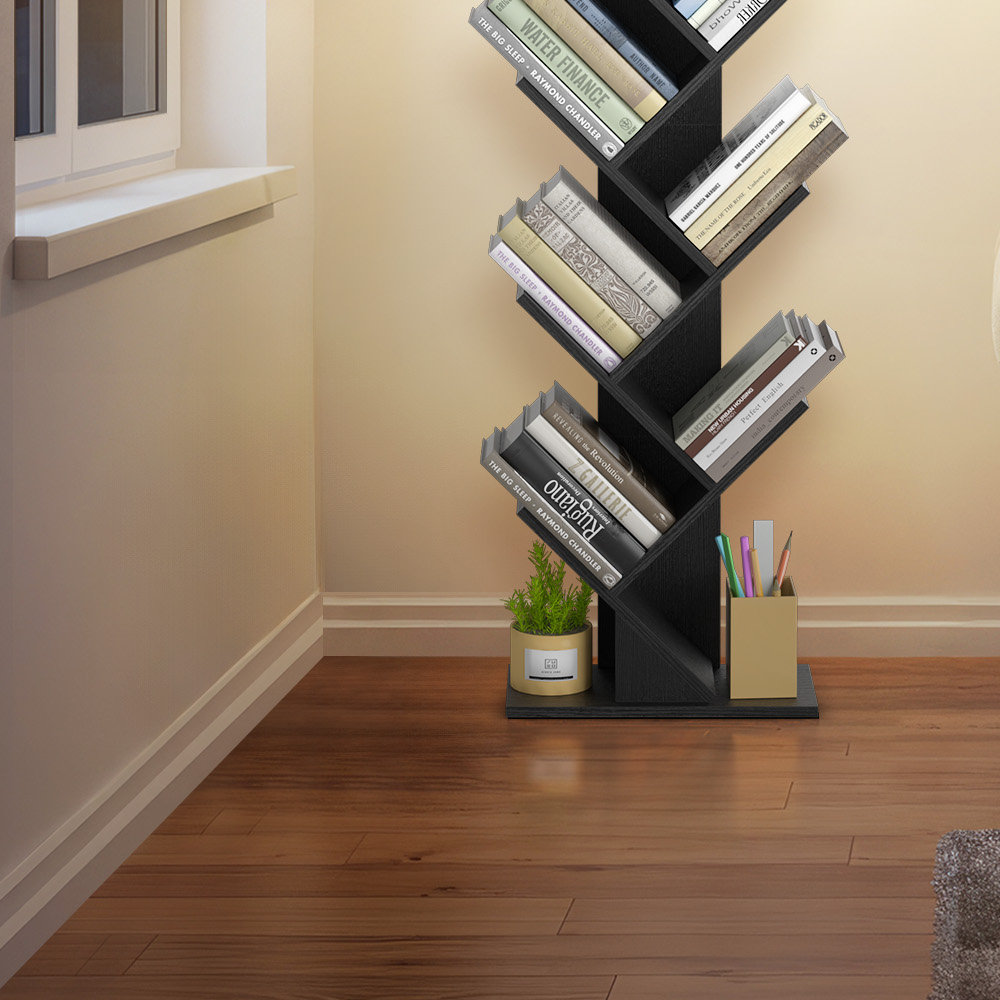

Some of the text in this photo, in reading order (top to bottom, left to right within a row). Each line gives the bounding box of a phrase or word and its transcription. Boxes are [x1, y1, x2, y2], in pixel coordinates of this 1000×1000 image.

[575, 0, 589, 13] END
[476, 17, 493, 33] THE
[490, 31, 506, 46] BIG
[504, 44, 526, 65] SLEEP
[529, 69, 568, 106] RAYMOND
[563, 103, 603, 141] CHANDLER
[518, 19, 563, 62] WATER
[555, 55, 611, 110] FINANCE
[629, 53, 666, 89] AUTHOR NAME
[734, 161, 742, 170] ONE
[542, 221, 561, 240] MOIR
[696, 229, 707, 241] THE
[705, 218, 719, 232] NAME
[722, 201, 736, 214] THE
[733, 191, 746, 203] ROSE
[496, 250, 511, 265] THE
[507, 261, 521, 275] BIG
[519, 273, 538, 292] SLEEP
[541, 294, 574, 326] RAYMOND
[571, 324, 604, 356] CHANDLER
[682, 403, 724, 444] MAKING IT
[707, 387, 754, 433] NEW URBAN HOUSING
[740, 402, 762, 424] Perfect
[761, 380, 785, 404] English
[551, 412, 626, 485] REVEALING the Revolution
[543, 478, 605, 542] Rugiano
[568, 458, 634, 522] Z GALLERIE
[488, 460, 602, 572] THE BIG SLEEP RAYMOND CHANDLER
